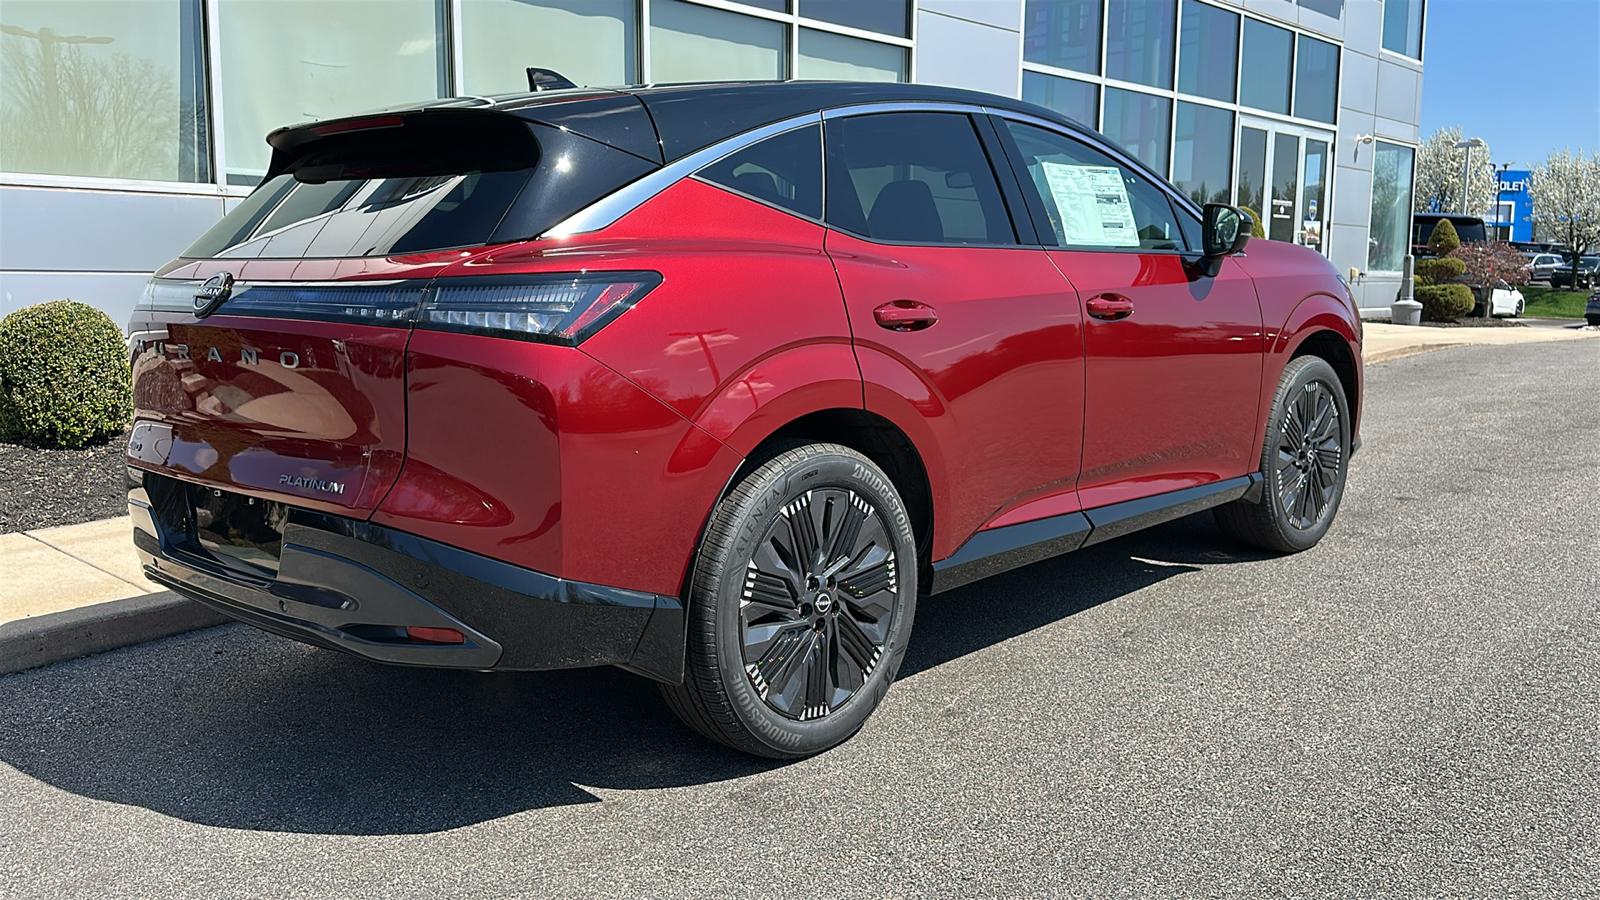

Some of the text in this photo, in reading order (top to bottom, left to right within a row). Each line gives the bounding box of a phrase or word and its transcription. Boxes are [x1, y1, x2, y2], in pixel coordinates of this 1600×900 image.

[1493, 180, 1524, 191] ROLET
[279, 474, 345, 494] PLATINUM
[851, 463, 912, 544] BRIDGESTONE
[736, 488, 780, 558] ALENZA
